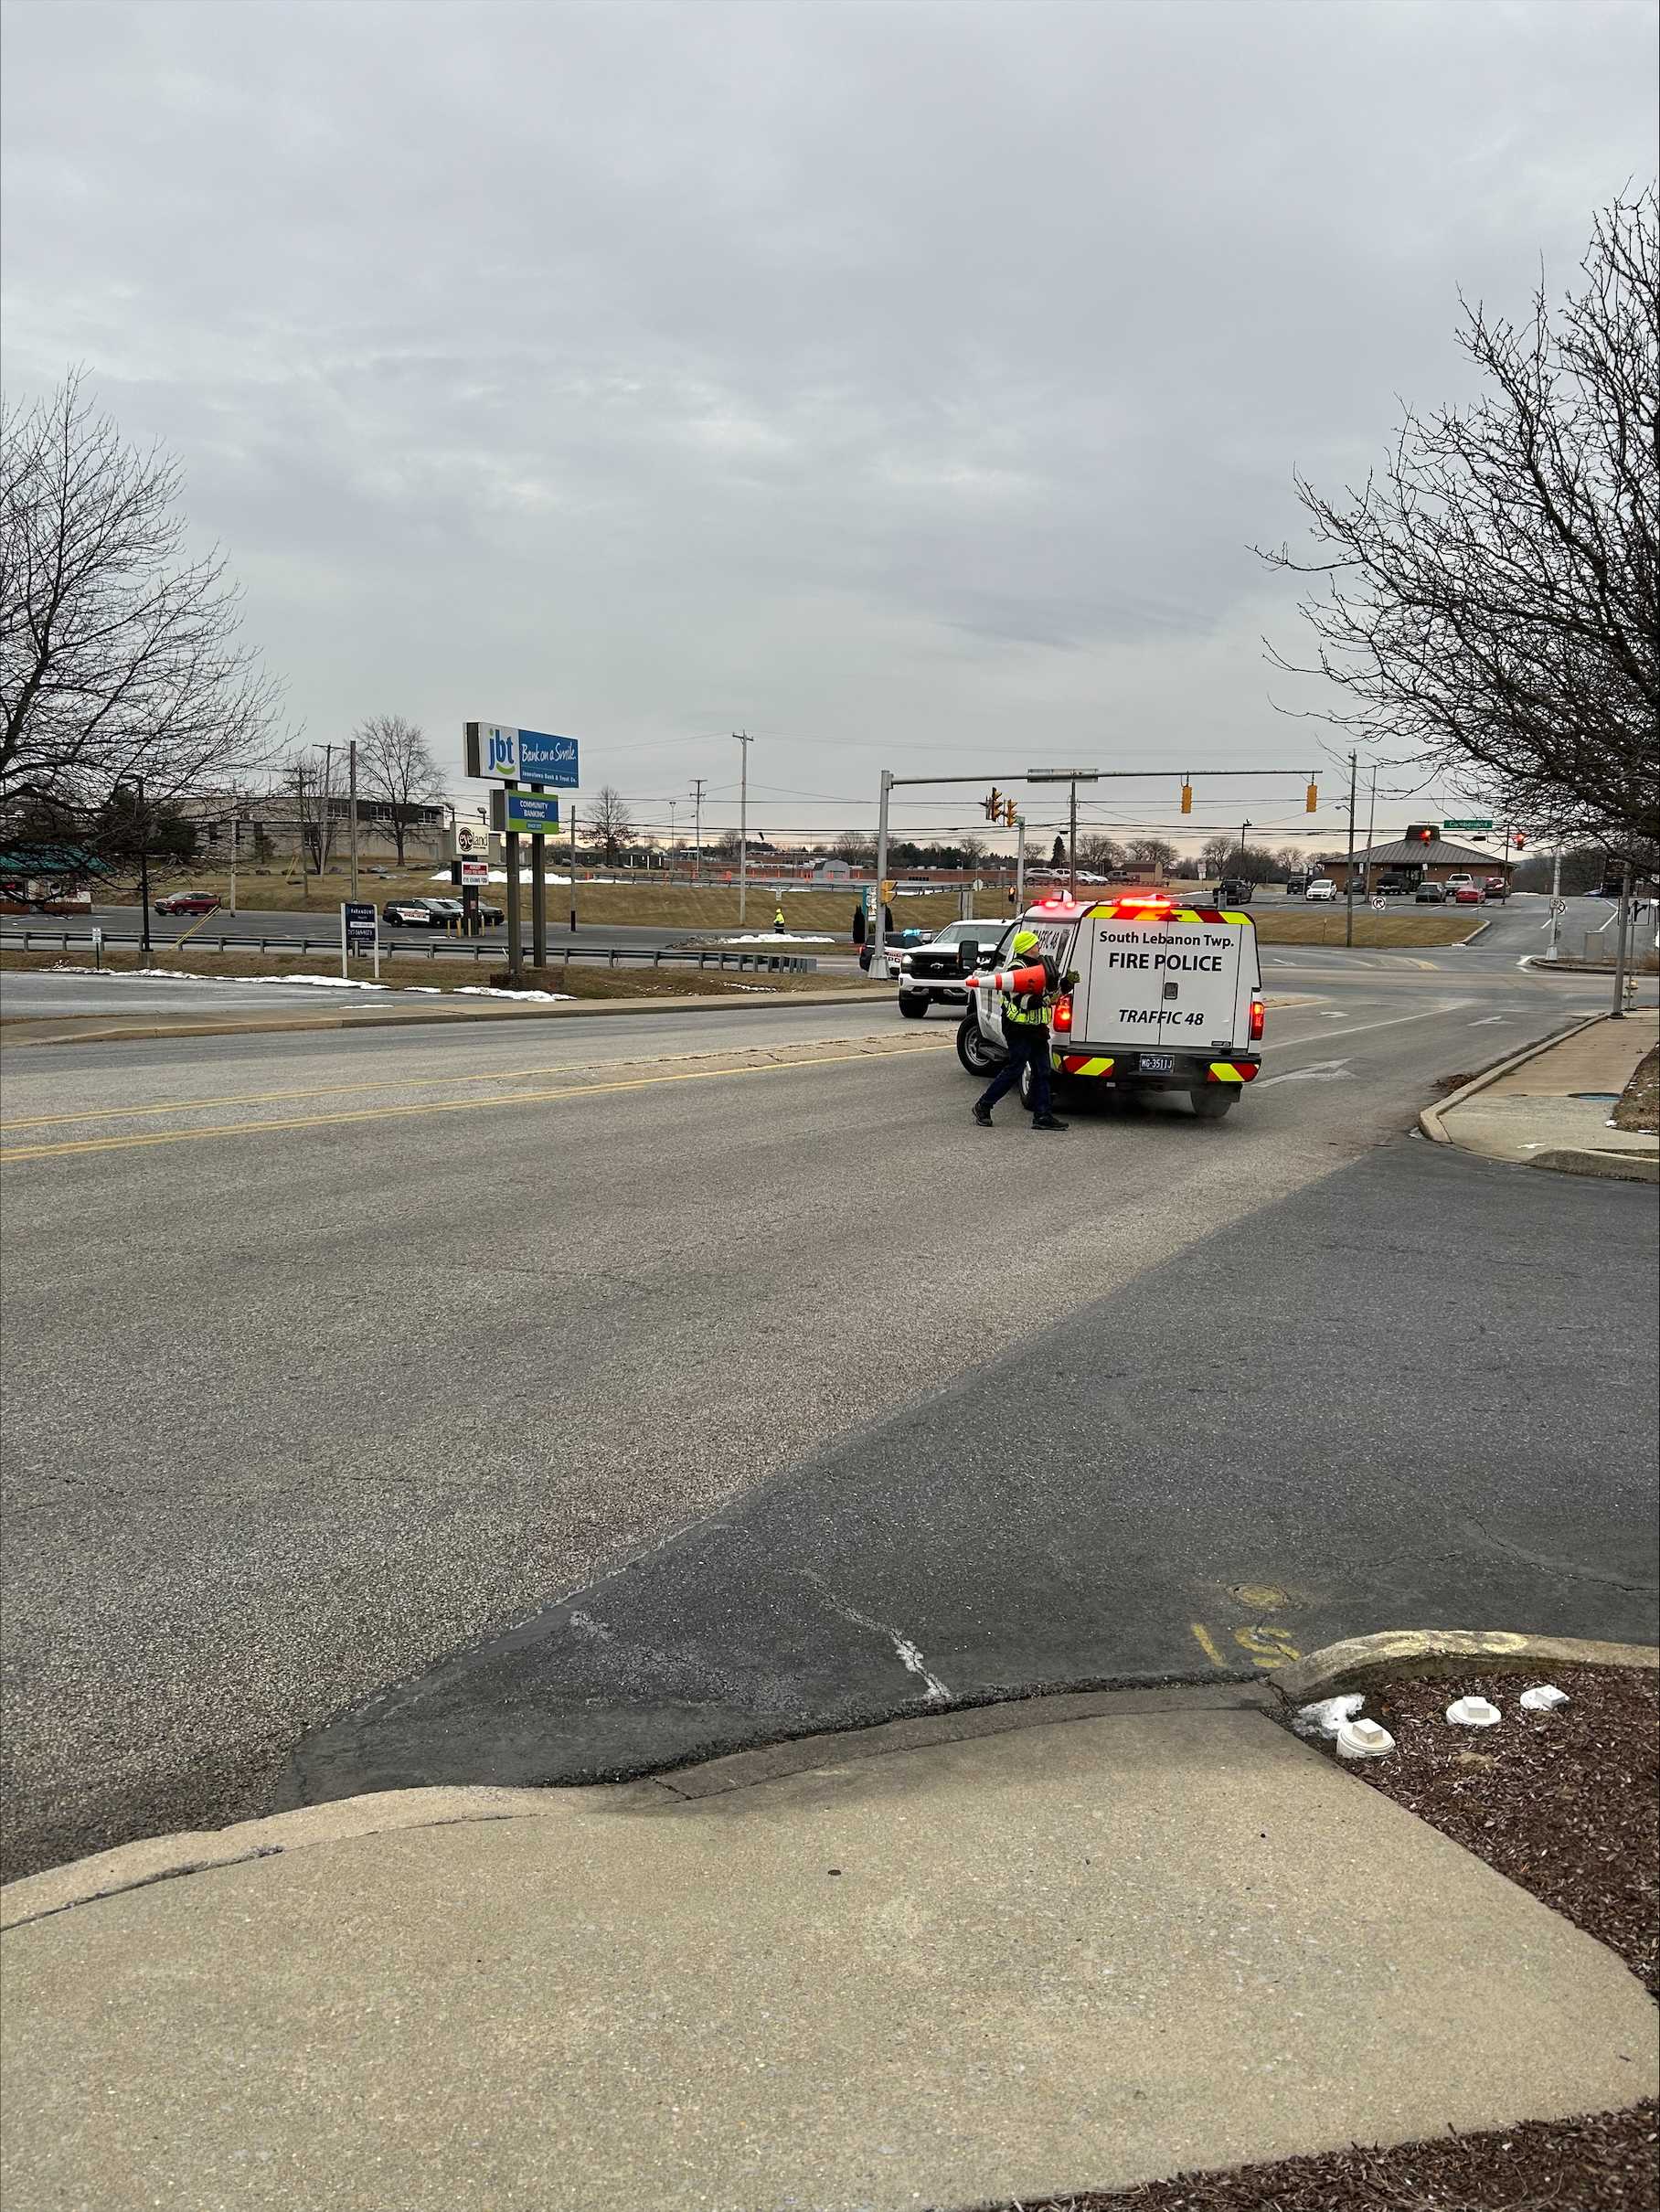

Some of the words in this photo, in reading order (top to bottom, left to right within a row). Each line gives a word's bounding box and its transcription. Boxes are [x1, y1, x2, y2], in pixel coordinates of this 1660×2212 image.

[488, 728, 515, 771] jbt
[521, 742, 540, 762] Bank
[540, 749, 549, 761] on
[549, 750, 556, 761] a
[519, 800, 548, 810] COMMUNITY
[524, 809, 546, 818] BANKING
[1100, 931, 1139, 944] South
[1143, 932, 1200, 946] Lebanon
[1204, 934, 1234, 949] Twp.
[1109, 952, 1149, 969] FIRE
[1154, 954, 1222, 972] POLICE
[1119, 1009, 1183, 1025] TRAFFIC
[1185, 1013, 1204, 1026] 48
